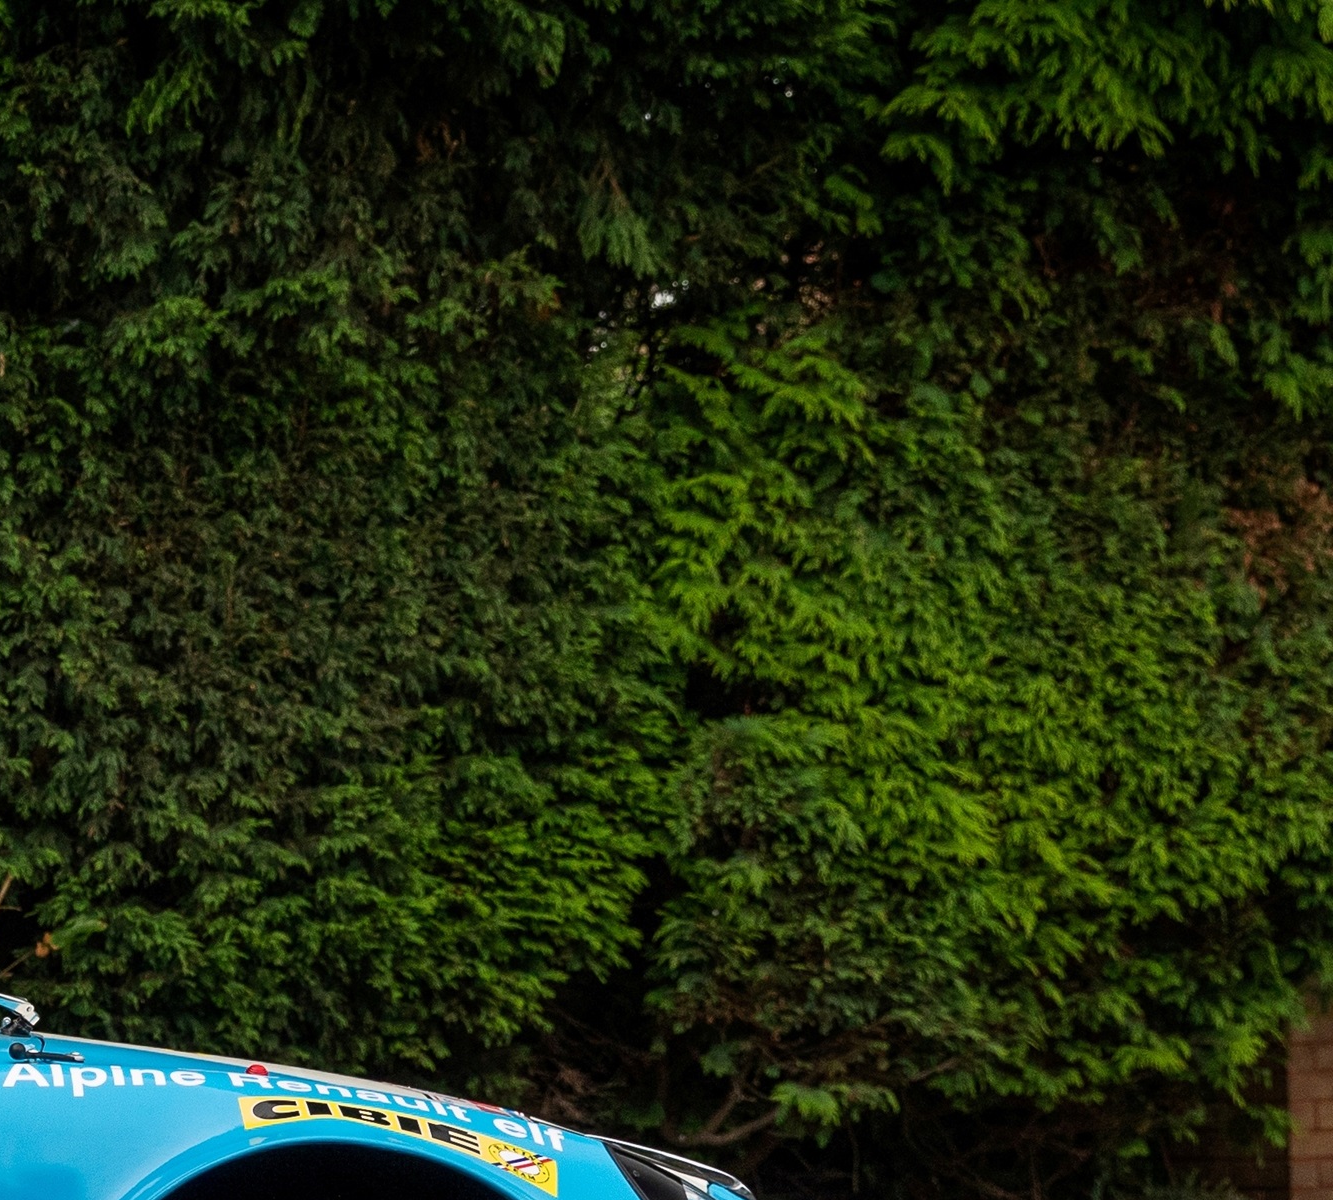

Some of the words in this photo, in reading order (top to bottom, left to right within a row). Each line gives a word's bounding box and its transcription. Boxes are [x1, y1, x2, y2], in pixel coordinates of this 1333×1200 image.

[2, 1062, 206, 1098] Alpine
[231, 1074, 472, 1124] Renault
[493, 1118, 565, 1152] elf
